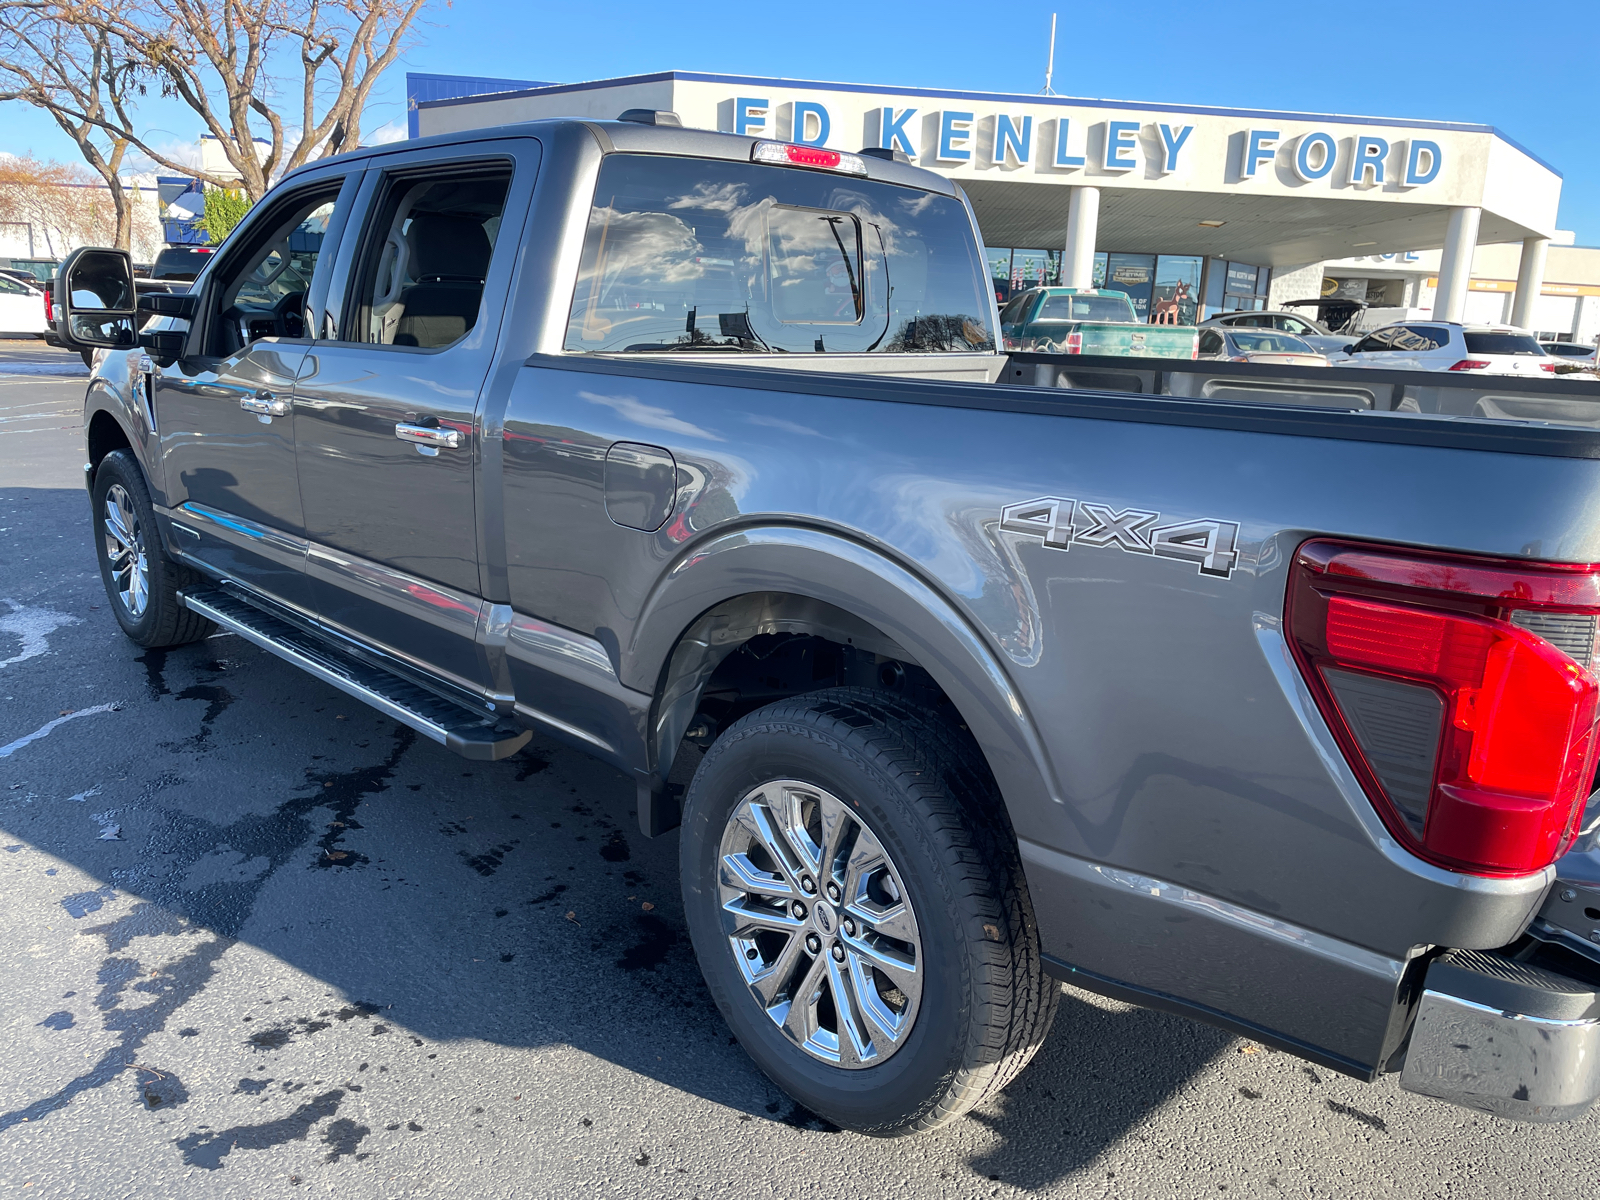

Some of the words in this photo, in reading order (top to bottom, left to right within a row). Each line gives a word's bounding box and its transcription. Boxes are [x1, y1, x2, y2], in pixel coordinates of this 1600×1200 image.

[734, 97, 830, 147] ED
[879, 106, 1196, 174] KENLEY
[1242, 128, 1442, 187] FORD
